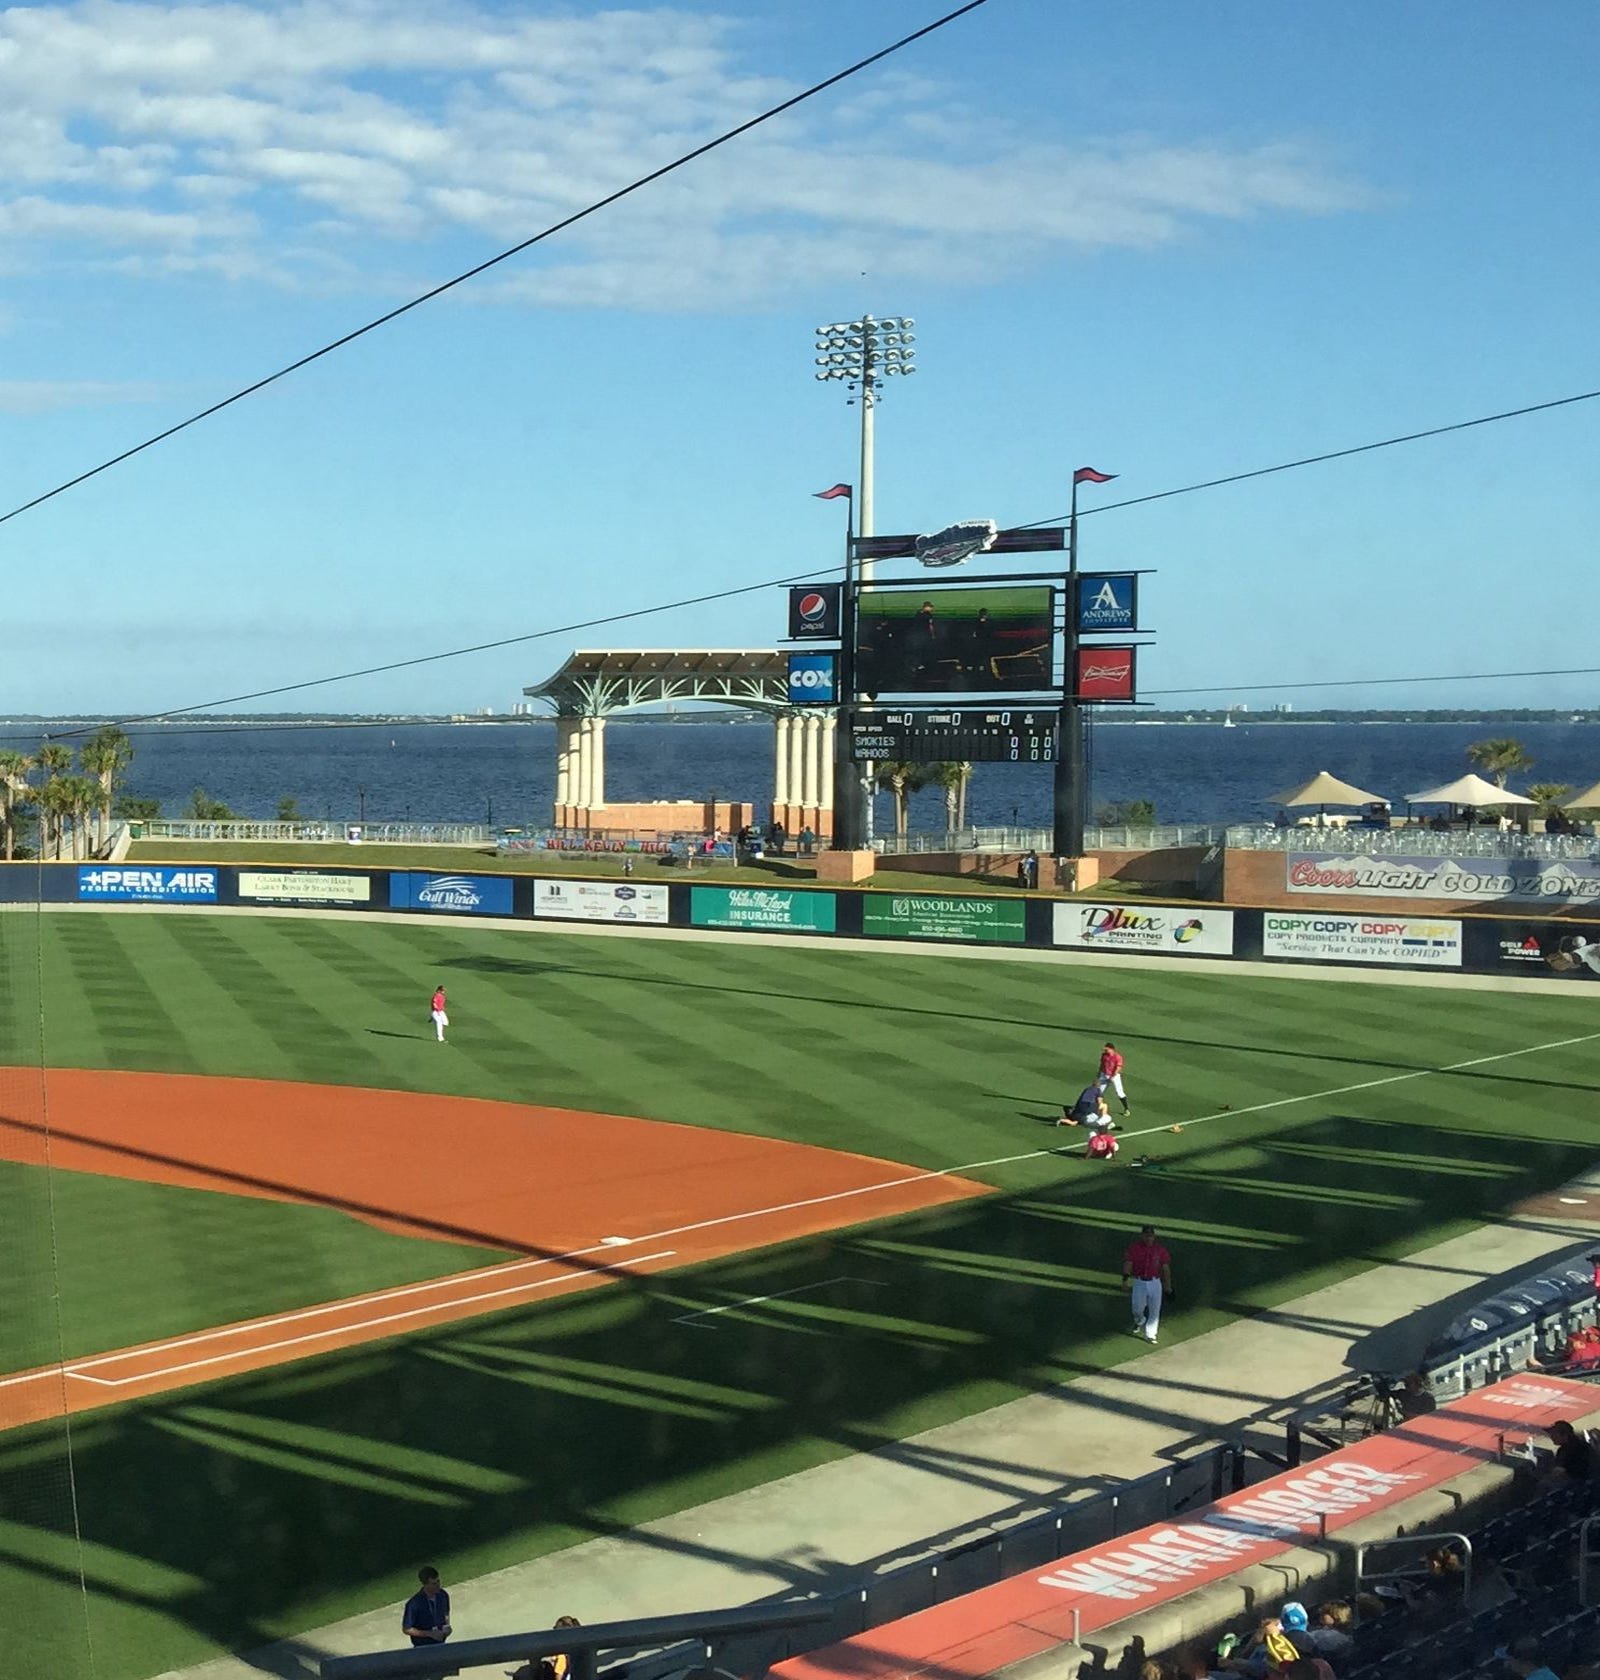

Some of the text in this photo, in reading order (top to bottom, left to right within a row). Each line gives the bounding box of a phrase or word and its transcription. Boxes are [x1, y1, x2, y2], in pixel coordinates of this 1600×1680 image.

[1082, 609, 1131, 618] ANDREWS
[800, 622, 825, 631] pepsi
[789, 668, 833, 688] COX
[887, 715, 903, 723] BALL
[904, 712, 913, 726] 0
[952, 712, 961, 726] 0
[1001, 712, 1011, 726] 0
[855, 736, 1052, 748] SMOKIES 0 0 0
[1011, 749, 1018, 760] 0
[1031, 749, 1038, 760] 0
[1044, 749, 1052, 760] 0
[585, 841, 626, 852] KELLY
[102, 871, 214, 888] PEN AIR
[1291, 859, 1600, 897] Coors LIGHT COLD ZONE
[419, 888, 479, 905] Gulf Winds
[911, 900, 993, 913] WOODLANDS
[730, 911, 791, 922] INSURANCE
[1081, 908, 1165, 931] Dlux
[1268, 919, 1312, 931] COPY
[1313, 921, 1359, 933] COPY
[1361, 923, 1408, 935] COPY
[1109, 931, 1162, 939] PRINTING
[1296, 934, 1347, 942] PRODUCTS
[1508, 948, 1540, 956] POWER
[1037, 1462, 1428, 1600] WHATABURGER
